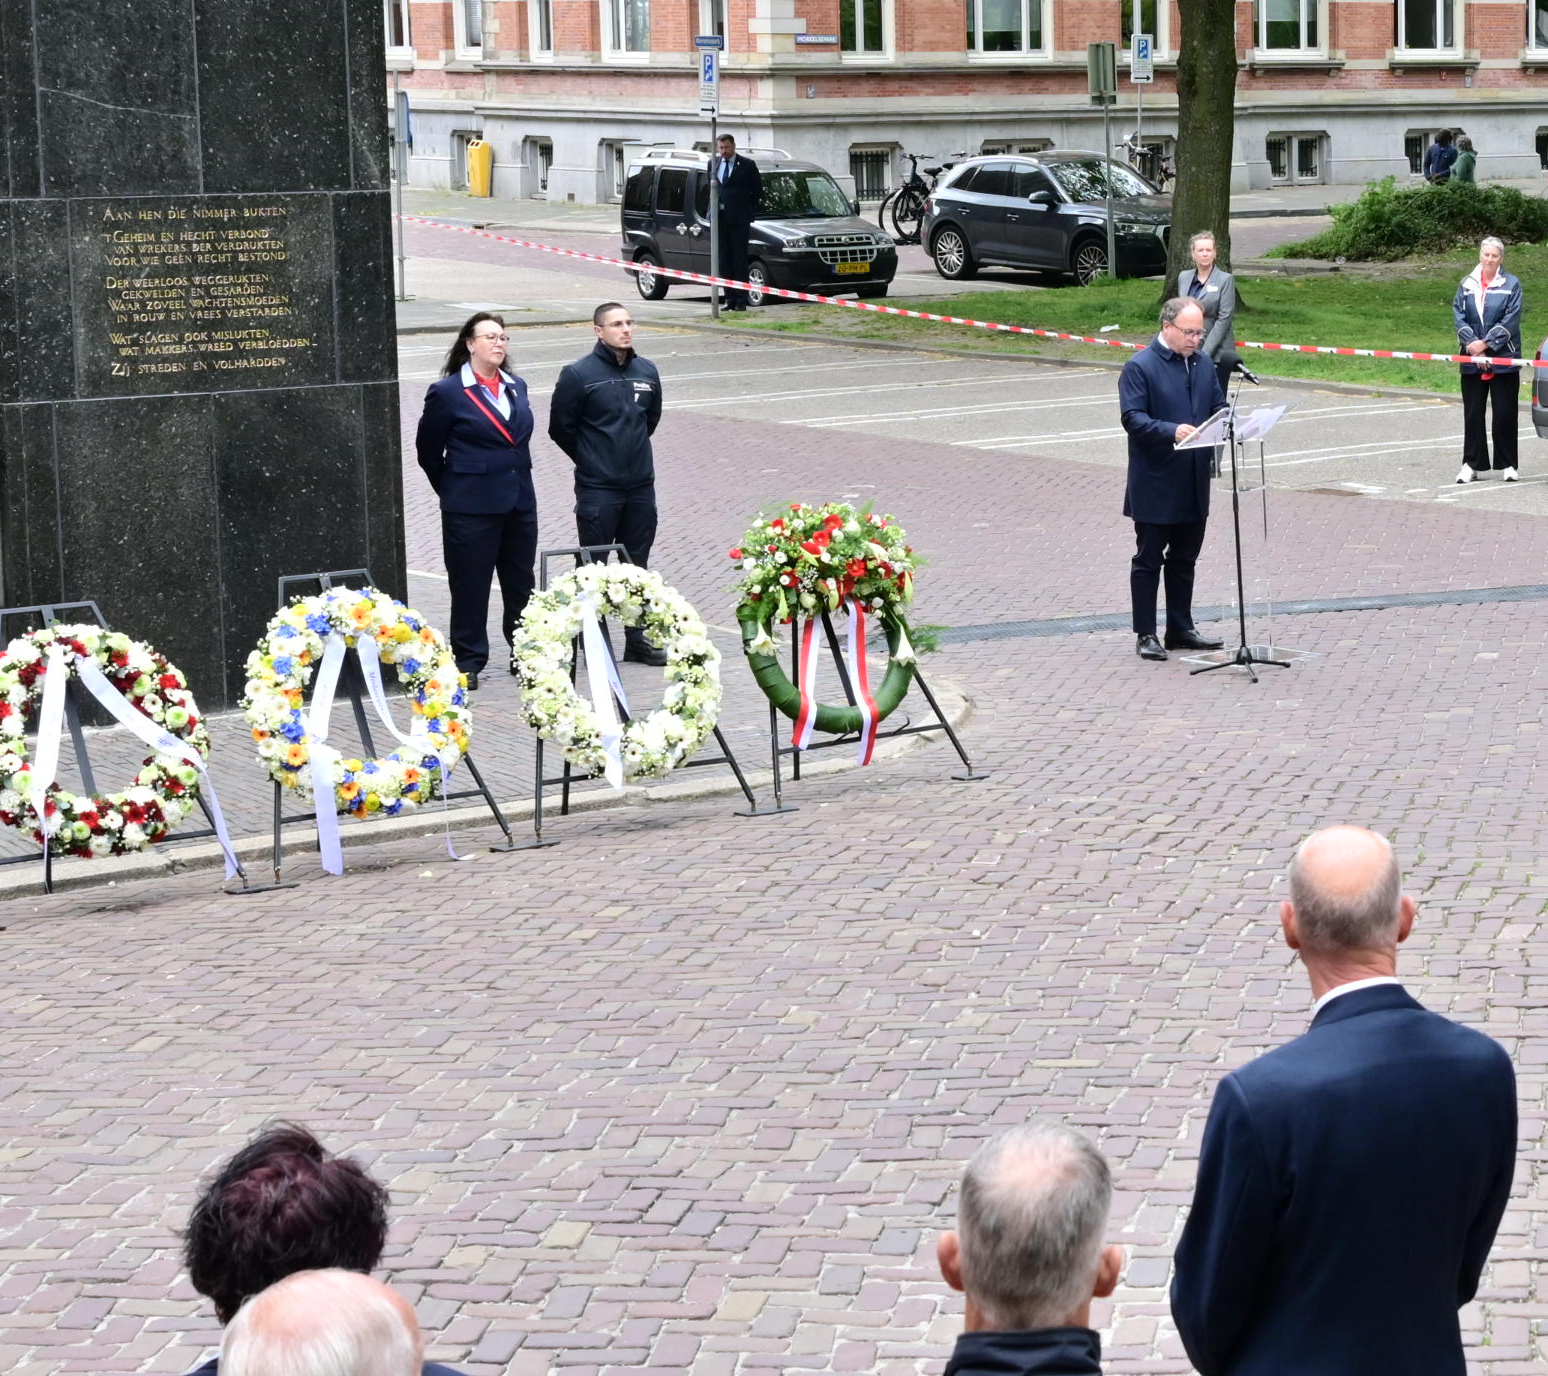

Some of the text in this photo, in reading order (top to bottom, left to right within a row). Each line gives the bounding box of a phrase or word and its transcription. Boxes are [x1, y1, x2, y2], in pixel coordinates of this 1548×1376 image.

[139, 210, 161, 220] HEN
[168, 209, 186, 219] DIE
[193, 208, 237, 219] NIMMER
[243, 207, 286, 217] BUKTEN
[161, 232, 174, 241] EN
[180, 231, 215, 241] HECHT
[114, 245, 134, 255] VAN
[192, 242, 212, 252] DER
[215, 240, 284, 251] VERDRUKTEN
[140, 256, 160, 265] WIE
[197, 253, 232, 263] RECHT
[132, 276, 188, 288] WEERLOOS
[122, 288, 186, 300] GEKWELDEN
[191, 287, 204, 297] EN
[146, 300, 186, 310] ZOVEEL
[117, 314, 128, 323] IN
[133, 312, 165, 323] ROUW
[171, 311, 185, 321] EN
[189, 309, 222, 320] VREES
[138, 332, 179, 344] SLAGEN
[184, 331, 208, 342] OOK
[119, 346, 139, 356] WAT
[198, 341, 233, 352] WREED
[138, 362, 186, 374] STREDEN
[193, 360, 207, 371] EN
[213, 357, 286, 369] VOLHARDDEN
